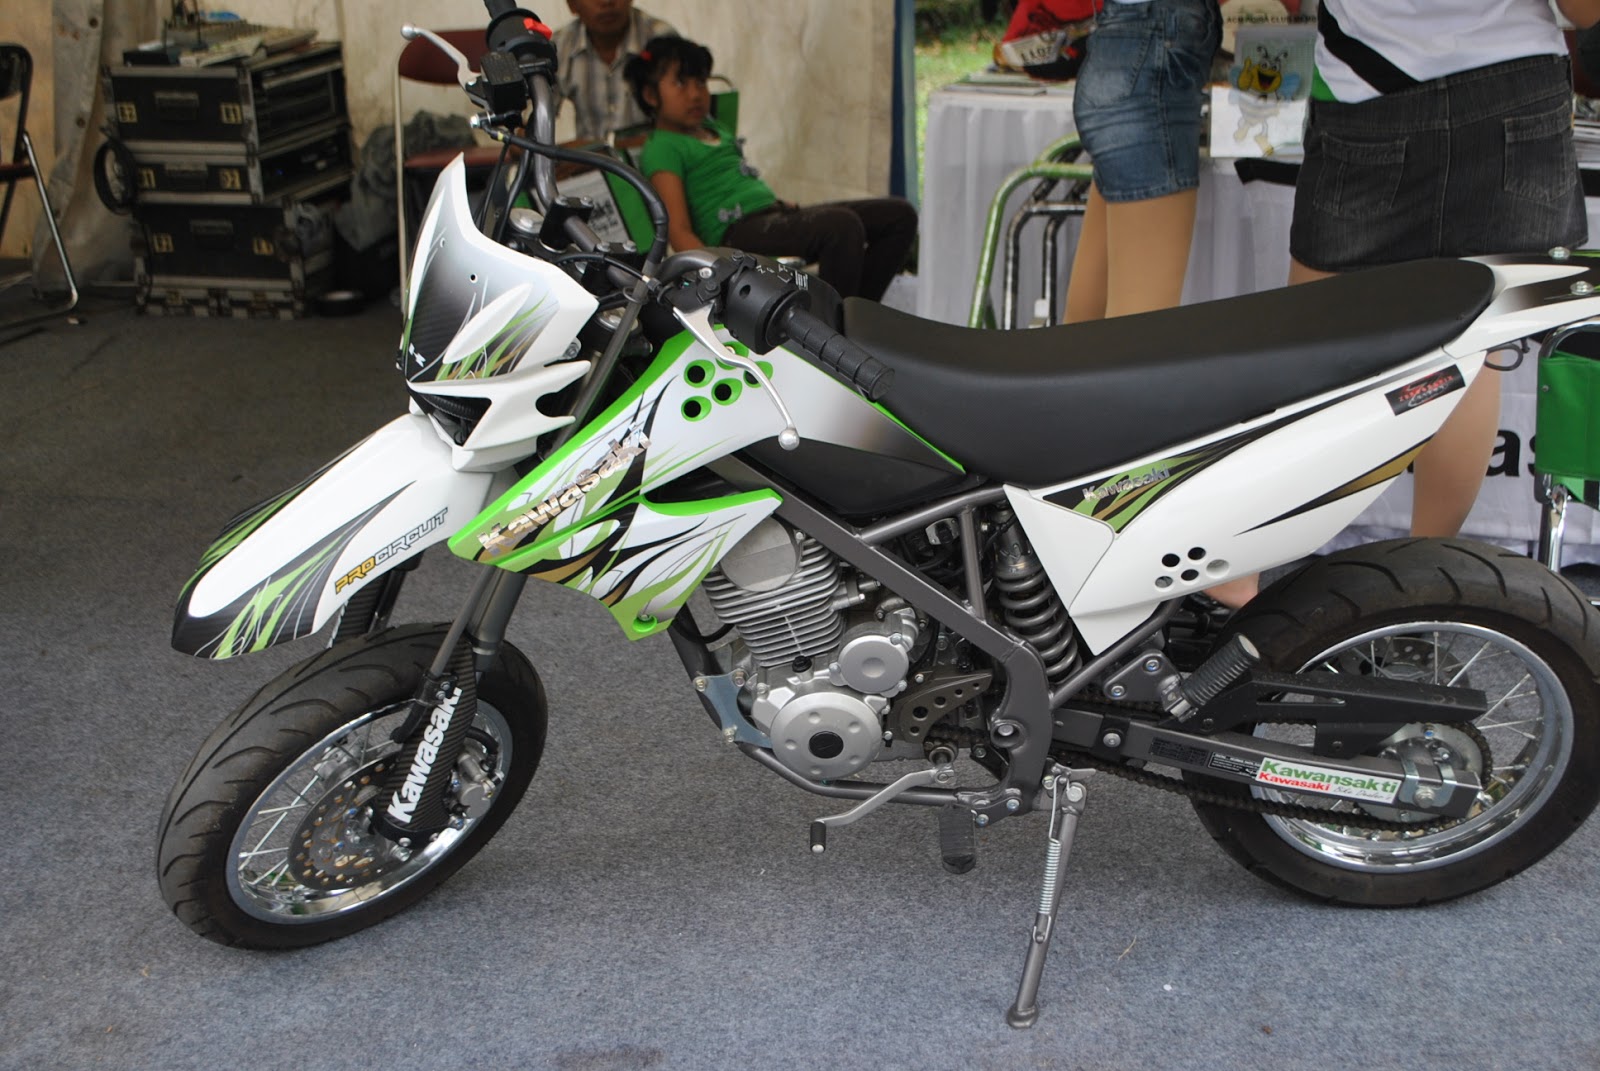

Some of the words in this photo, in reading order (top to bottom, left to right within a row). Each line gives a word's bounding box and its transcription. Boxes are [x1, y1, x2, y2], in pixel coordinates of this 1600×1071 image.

[477, 421, 652, 556] Kawasaki
[1082, 464, 1170, 502] Kawasaki
[1258, 772, 1331, 792] Kawasaki
